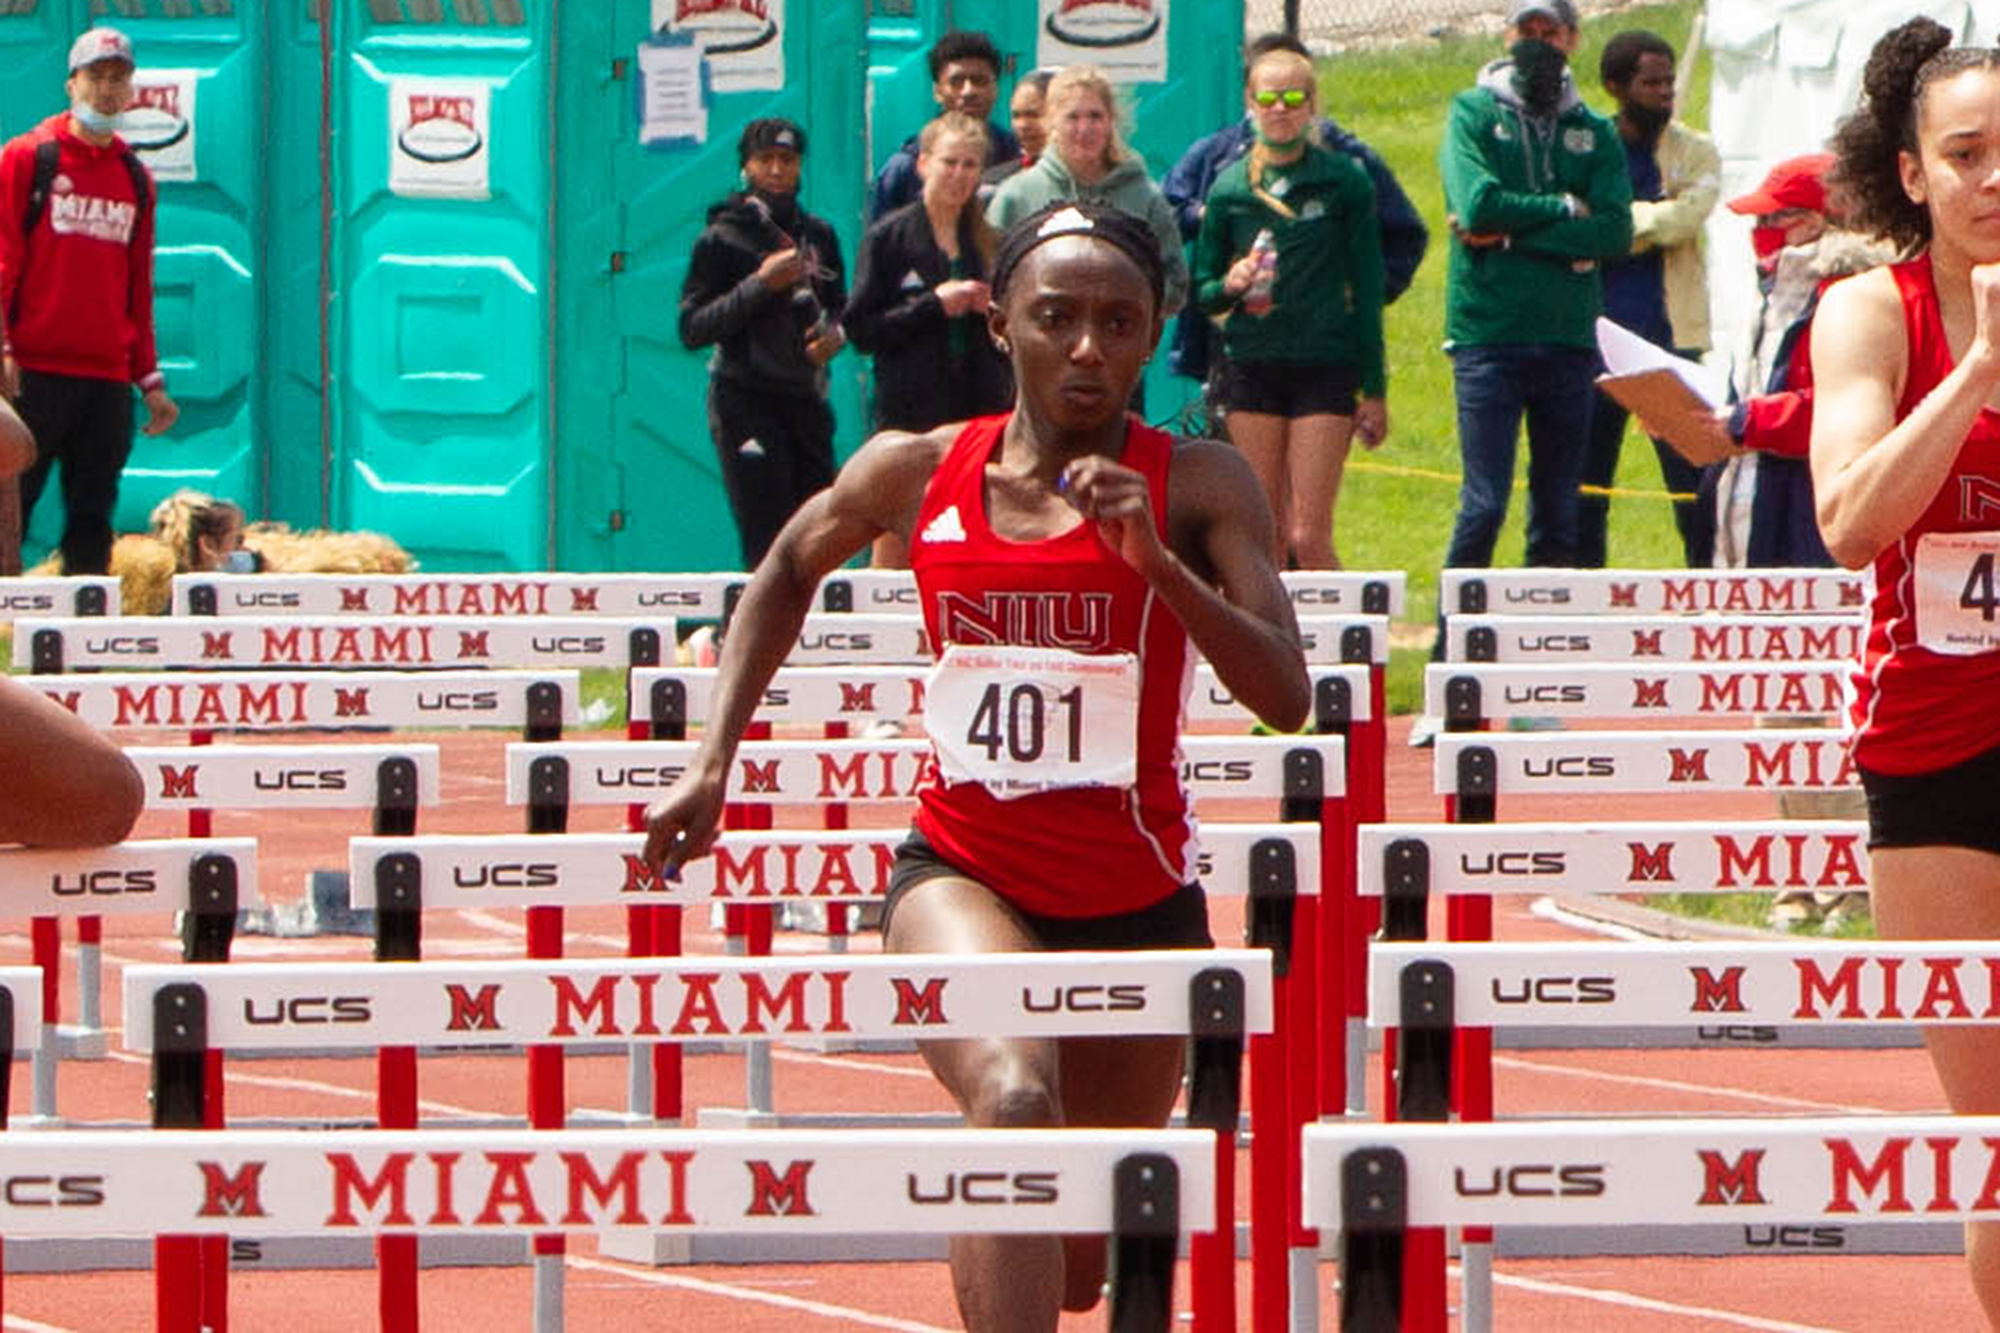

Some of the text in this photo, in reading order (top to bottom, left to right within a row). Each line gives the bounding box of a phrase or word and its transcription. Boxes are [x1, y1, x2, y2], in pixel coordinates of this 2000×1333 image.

[236, 583, 701, 615] UCS M MIAMI M UCS
[872, 588, 1340, 604] UC CS
[1506, 588, 1571, 604] UCS
[1610, 583, 1638, 607] M
[1662, 578, 1817, 611] MIAMI
[937, 591, 1112, 651] NIU
[86, 626, 605, 663] UCS M MIAMI M UCS
[801, 634, 872, 650] UCS
[1519, 625, 1862, 660] UCS M MIAMI
[113, 682, 308, 725] MIAMI
[334, 688, 370, 717] M
[418, 692, 498, 711] UCS
[839, 683, 876, 712] M
[1505, 686, 1585, 704] UCS
[1632, 679, 1669, 708] M
[967, 683, 1082, 763] 401
[159, 765, 346, 798] M UCS
[741, 759, 782, 793] M
[1183, 761, 1253, 782] CS
[1524, 757, 1615, 777] UCS
[1668, 748, 1709, 782] M
[454, 864, 558, 888] UCS
[1461, 834, 1867, 887] UCS M MIA
[52, 871, 156, 896] UCS
[245, 971, 1146, 1037] UCS M MIAMI M UCS
[1492, 957, 2000, 1019] UCS M MIA
[1698, 1025, 1778, 1041] UCS
[4, 1150, 1059, 1227] CS M MIAMI M UCS
[1454, 1149, 1767, 1206] UCS M
[1745, 1225, 1844, 1247] UCS
